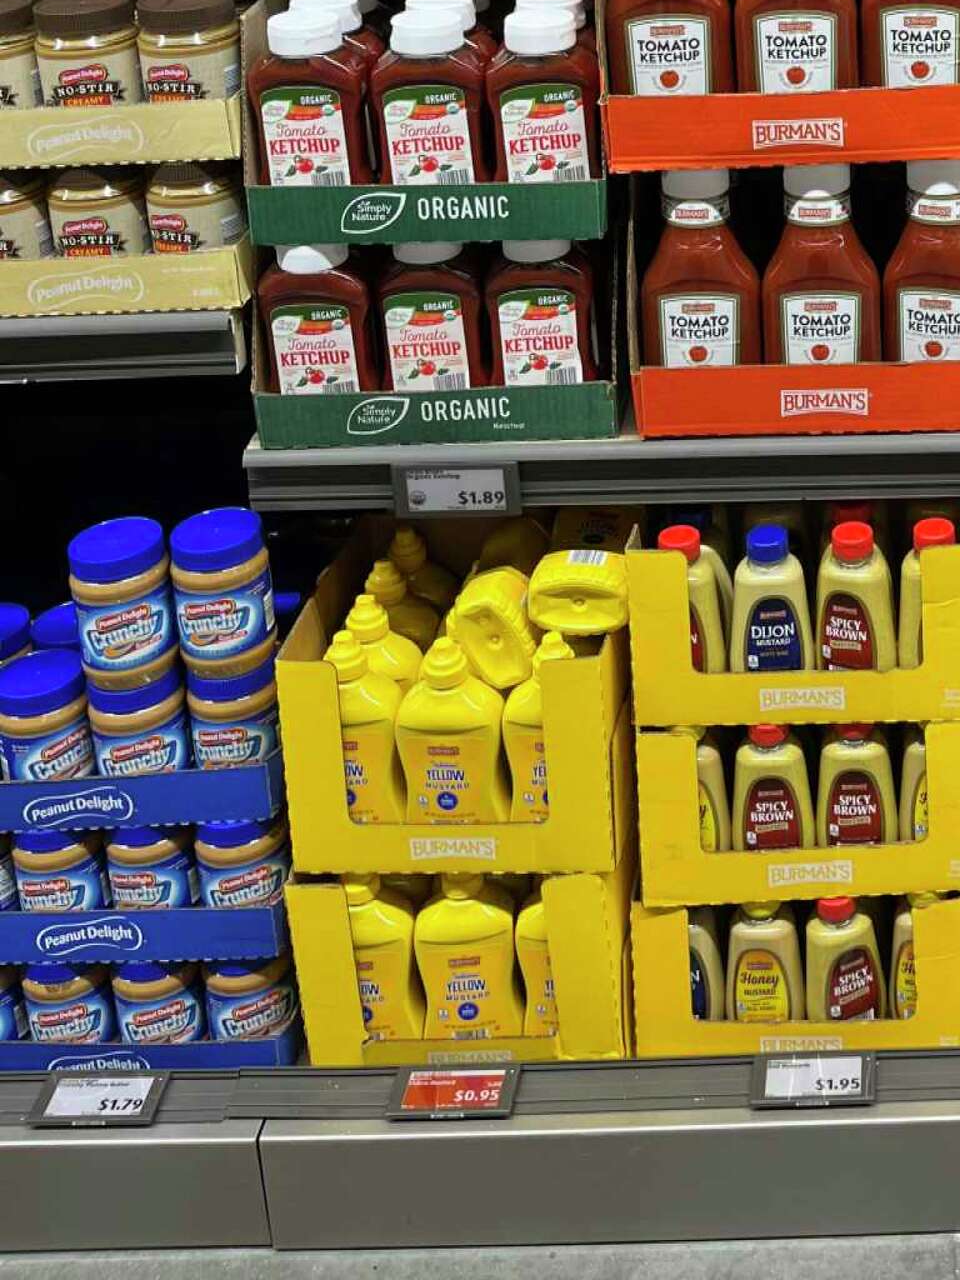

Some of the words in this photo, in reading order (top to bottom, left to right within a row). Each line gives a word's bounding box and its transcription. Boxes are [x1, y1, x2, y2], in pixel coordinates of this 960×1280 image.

[766, 35, 827, 48] TOMATO
[891, 30, 951, 42] TOMATO
[638, 39, 700, 52] TOMATO
[893, 42, 950, 54] KETCHUP
[640, 50, 700, 64] KETCHUP
[768, 47, 826, 60] KETCHUP
[58, 83, 114, 96] NO-STIR
[275, 122, 326, 137] Tomato
[400, 122, 450, 137] Tomato
[518, 121, 568, 136] Tomato
[756, 123, 841, 144] BURMAN'S
[270, 138, 340, 155] KETCHUP
[392, 136, 465, 156] KETCHUP
[509, 133, 581, 154] KETCHUP
[357, 202, 392, 215] Simply
[418, 197, 509, 221] ORGANIC
[62, 235, 114, 246] NO-STIR
[669, 315, 729, 328] TOMATO
[792, 314, 851, 327] TOMATO
[400, 328, 448, 341] Tomato
[512, 323, 561, 336] Tomato
[671, 327, 728, 338] KETCHUP
[793, 325, 850, 337] KETCHUP
[288, 338, 336, 351] Tomato
[392, 343, 461, 359] KETCHUP
[505, 336, 574, 353] KETCHUP
[281, 352, 350, 367] KETCHUP
[783, 392, 866, 413] BURMAN'S
[421, 398, 510, 422] ORGANIC
[458, 491, 505, 506] $1.89
[830, 617, 861, 630] SPICY
[751, 623, 795, 639] DIJON
[825, 626, 867, 641] BROWN
[762, 690, 842, 708] BURMAN'S
[426, 769, 465, 781] YELLOW
[756, 801, 788, 812] SPICY
[839, 794, 871, 806] SPICY
[32, 804, 75, 820] Peanut
[76, 796, 124, 812] Delight
[834, 804, 876, 816] BROWN
[751, 810, 793, 822] BROWN
[412, 840, 494, 857] BURMAN'S
[45, 931, 86, 949] Peanut
[88, 925, 133, 942] Delight
[447, 979, 486, 994] YELLOW
[739, 972, 779, 987] Honey
[815, 1077, 860, 1091] $1.95
[454, 1090, 500, 1102] $0.95
[99, 1098, 143, 1112] $1.79
